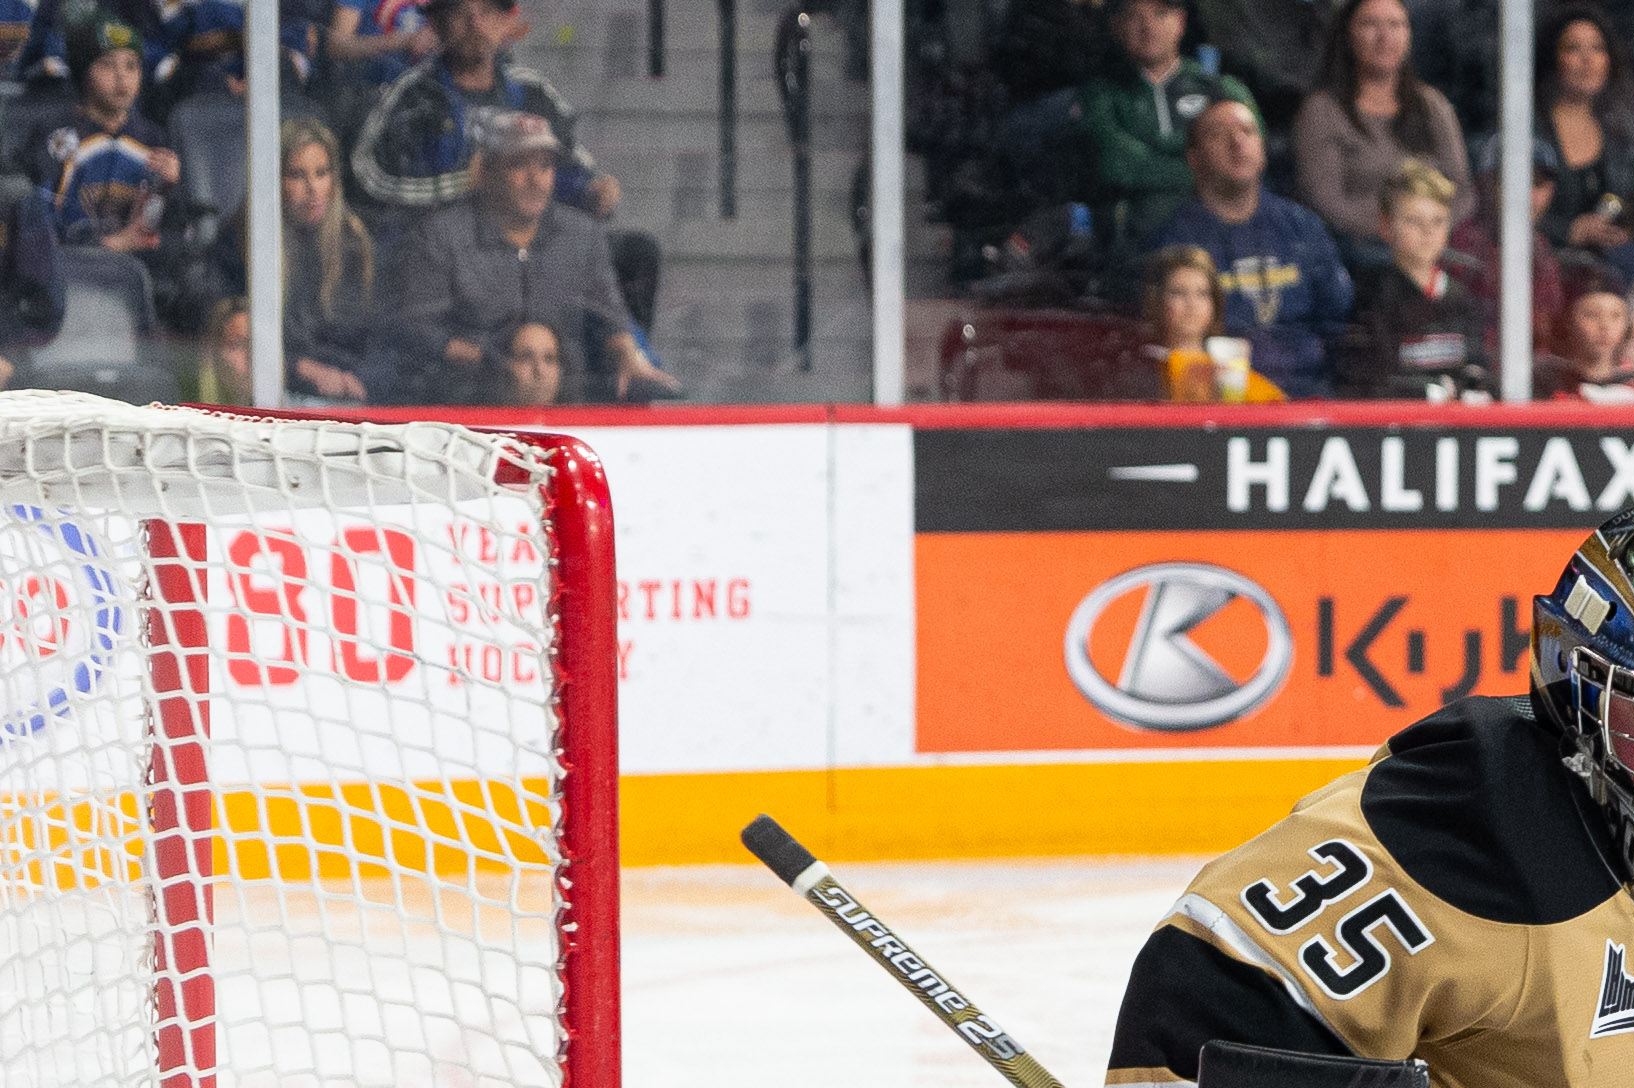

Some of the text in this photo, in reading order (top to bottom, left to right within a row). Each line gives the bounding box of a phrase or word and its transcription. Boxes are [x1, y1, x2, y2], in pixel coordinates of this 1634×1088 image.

[227, 527, 415, 686] 80
[447, 577, 752, 624] SUPRTING
[447, 641, 634, 689] HOCY
[1240, 838, 1436, 1001] 35
